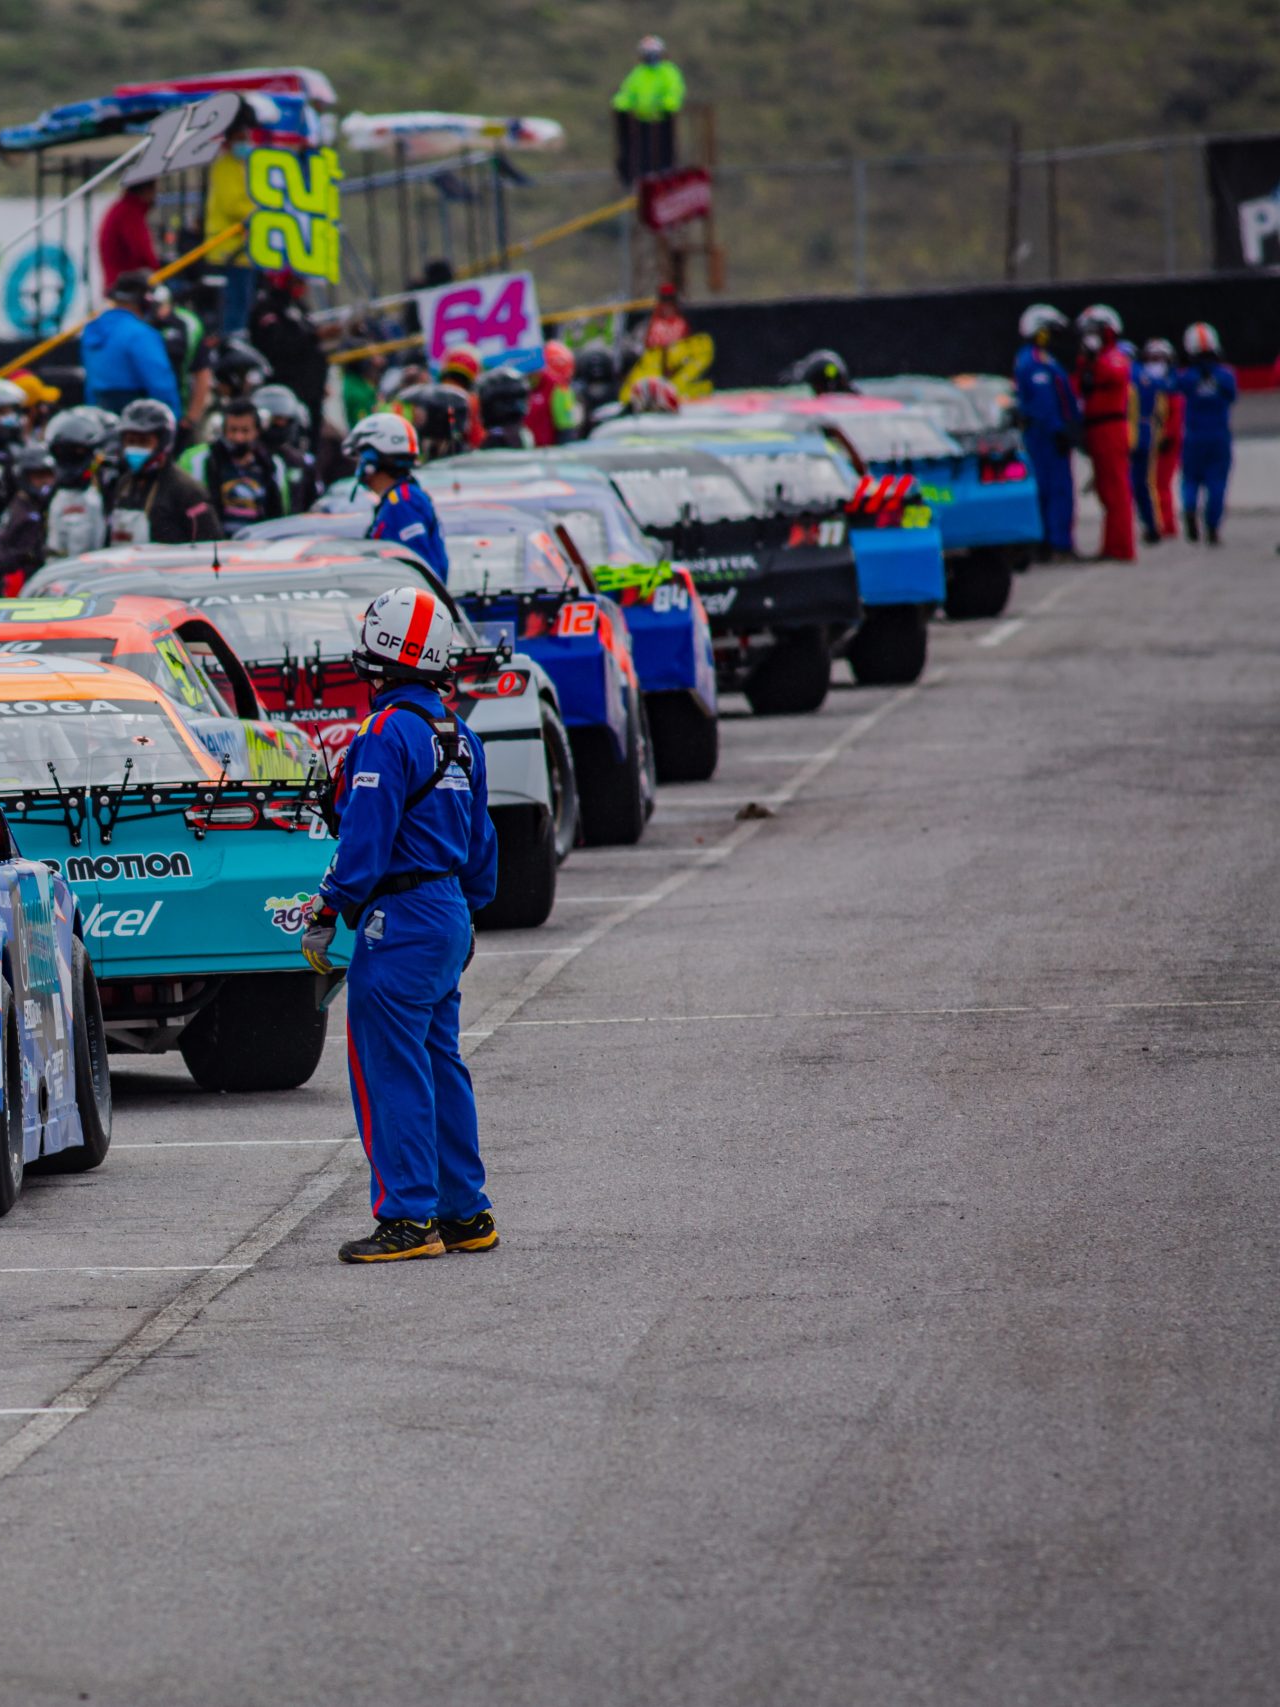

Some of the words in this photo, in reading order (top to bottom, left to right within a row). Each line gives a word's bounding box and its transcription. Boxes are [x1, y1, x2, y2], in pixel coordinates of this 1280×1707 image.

[652, 585, 688, 613] 84
[558, 602, 597, 636] 12
[376, 631, 441, 664] OFICIAL
[290, 707, 348, 721] AZÚCAR
[69, 850, 193, 884] MOTION
